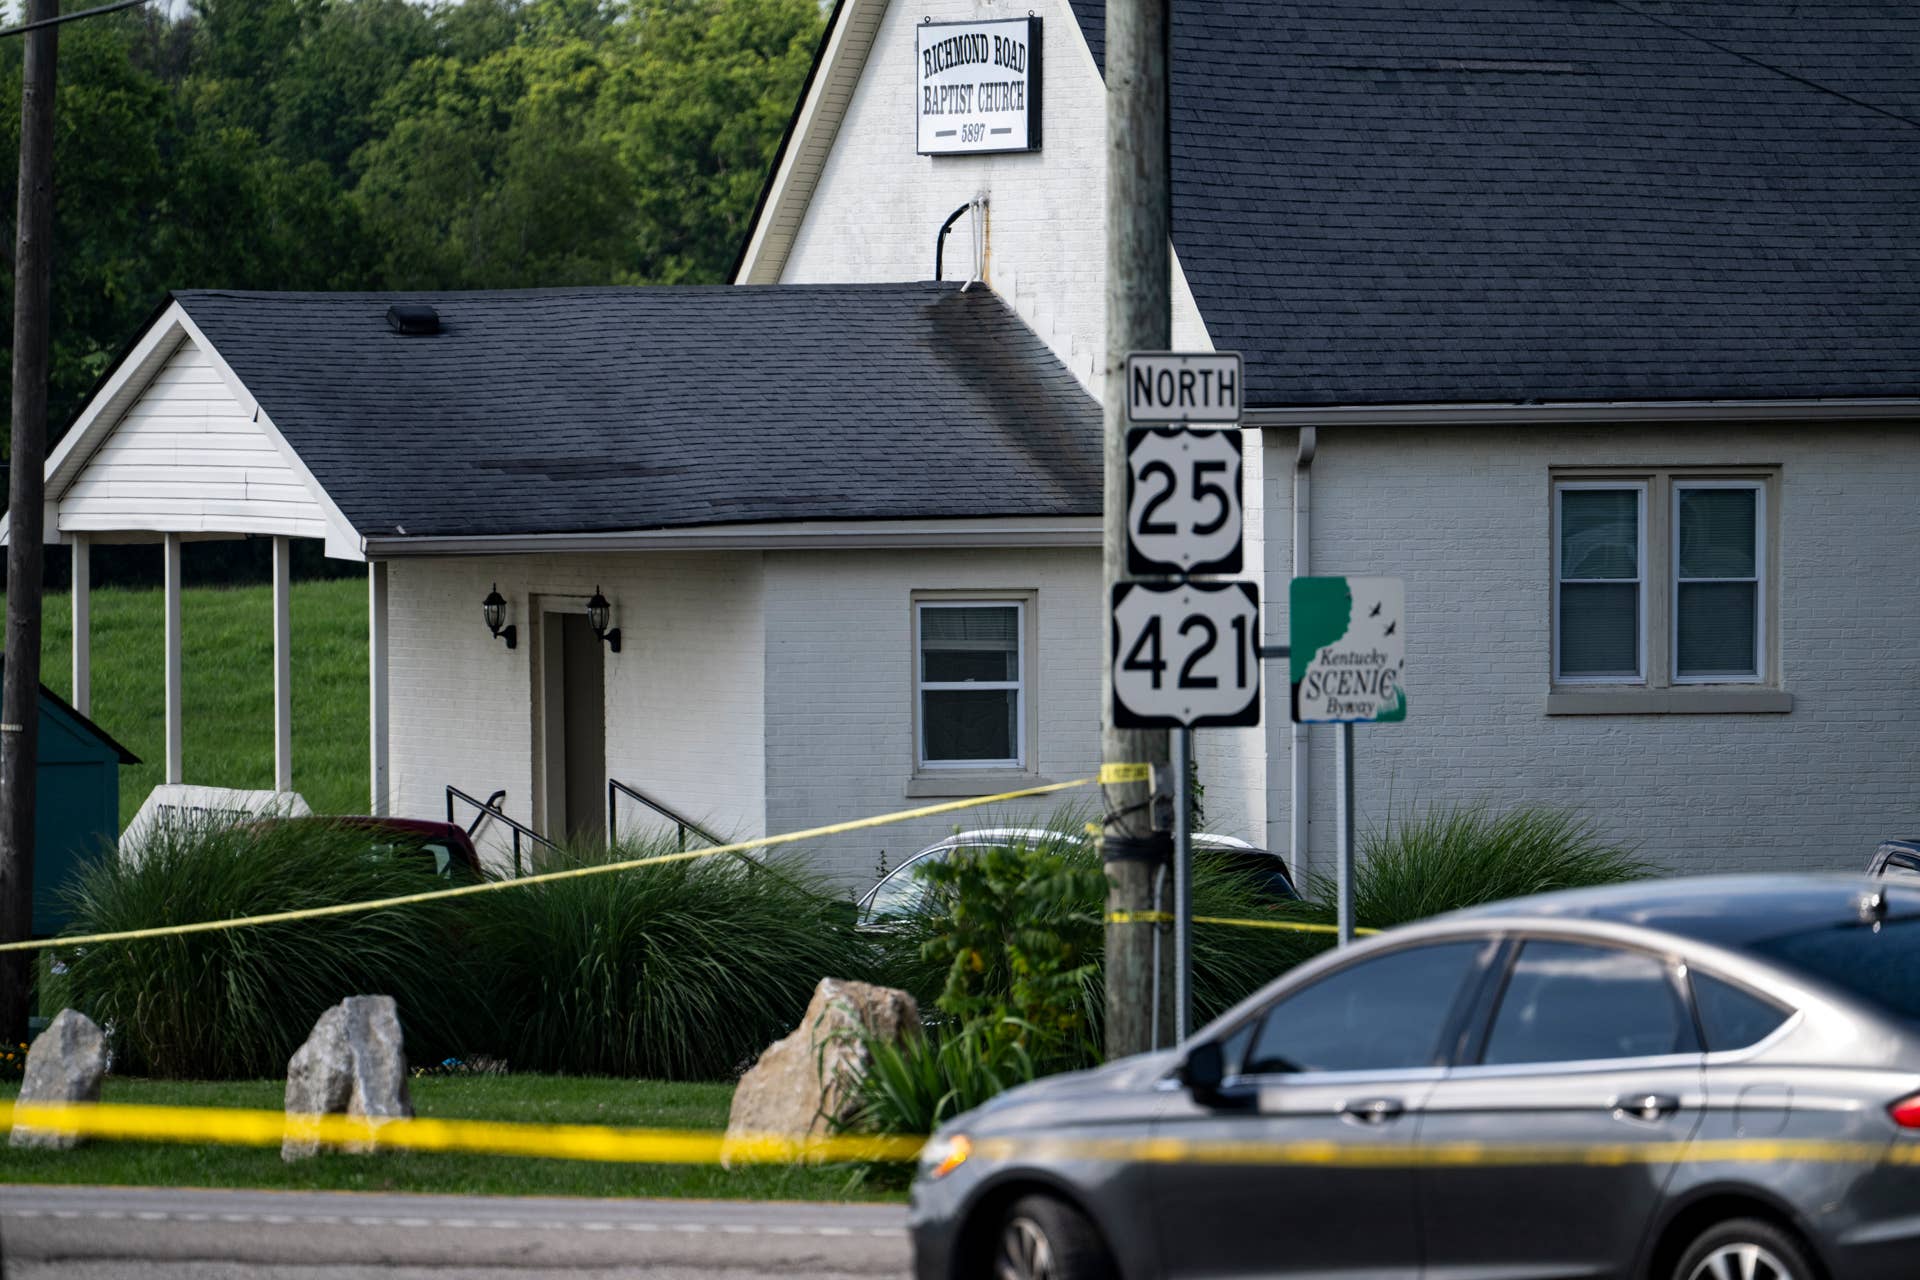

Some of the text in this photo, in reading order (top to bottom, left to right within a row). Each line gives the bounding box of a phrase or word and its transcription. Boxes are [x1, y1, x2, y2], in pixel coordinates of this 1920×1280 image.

[923, 33, 1026, 79] RICHMOND ROAD
[923, 80, 1024, 115] BAPTIST CHURCH
[961, 123, 986, 143] 5897
[1134, 365, 1235, 407] NORTH
[1138, 460, 1230, 535] 25
[1123, 613, 1247, 689] 421
[1321, 649, 1387, 668] Kentucky
[1306, 668, 1397, 700] SCENIC
[1327, 697, 1376, 717] Byway
